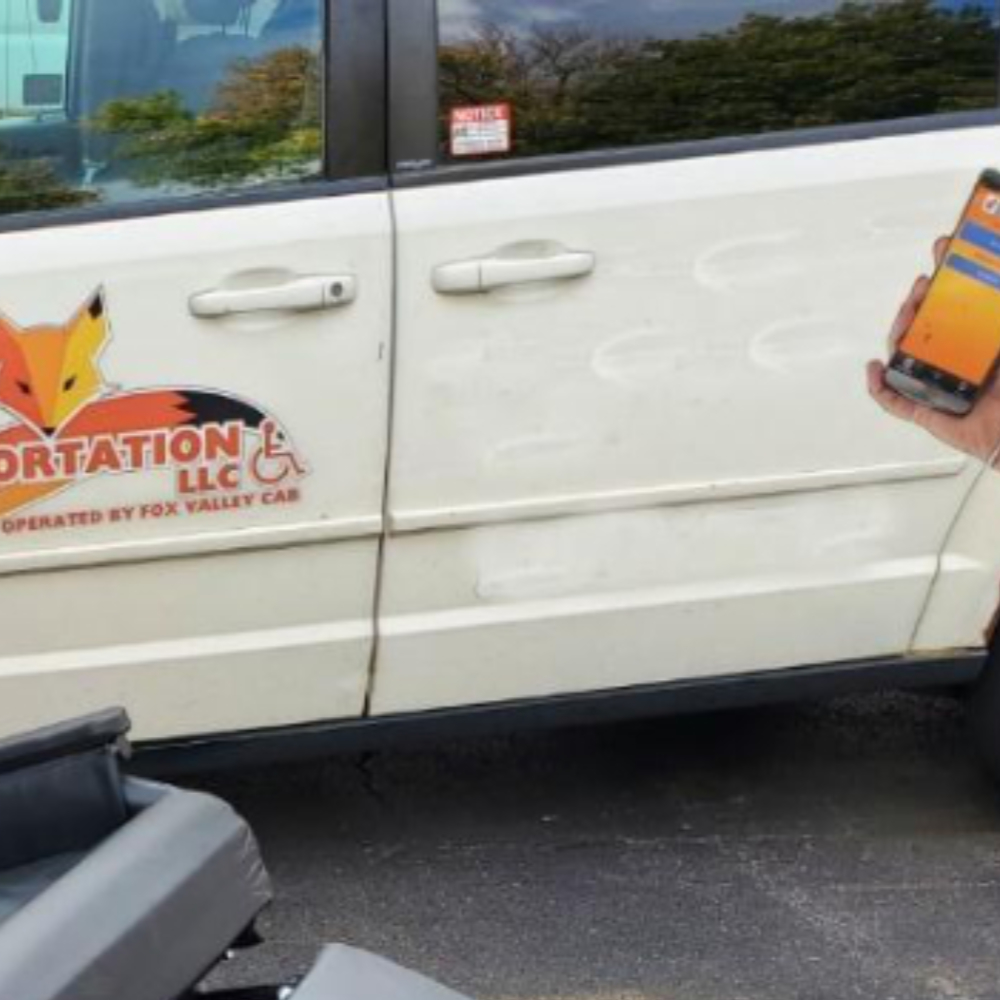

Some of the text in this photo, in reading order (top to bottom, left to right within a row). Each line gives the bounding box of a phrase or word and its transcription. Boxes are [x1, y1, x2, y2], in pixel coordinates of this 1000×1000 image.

[178, 464, 240, 493] LLC
[1, 488, 299, 533] OPERATED BY FOX VALLEY CAB
